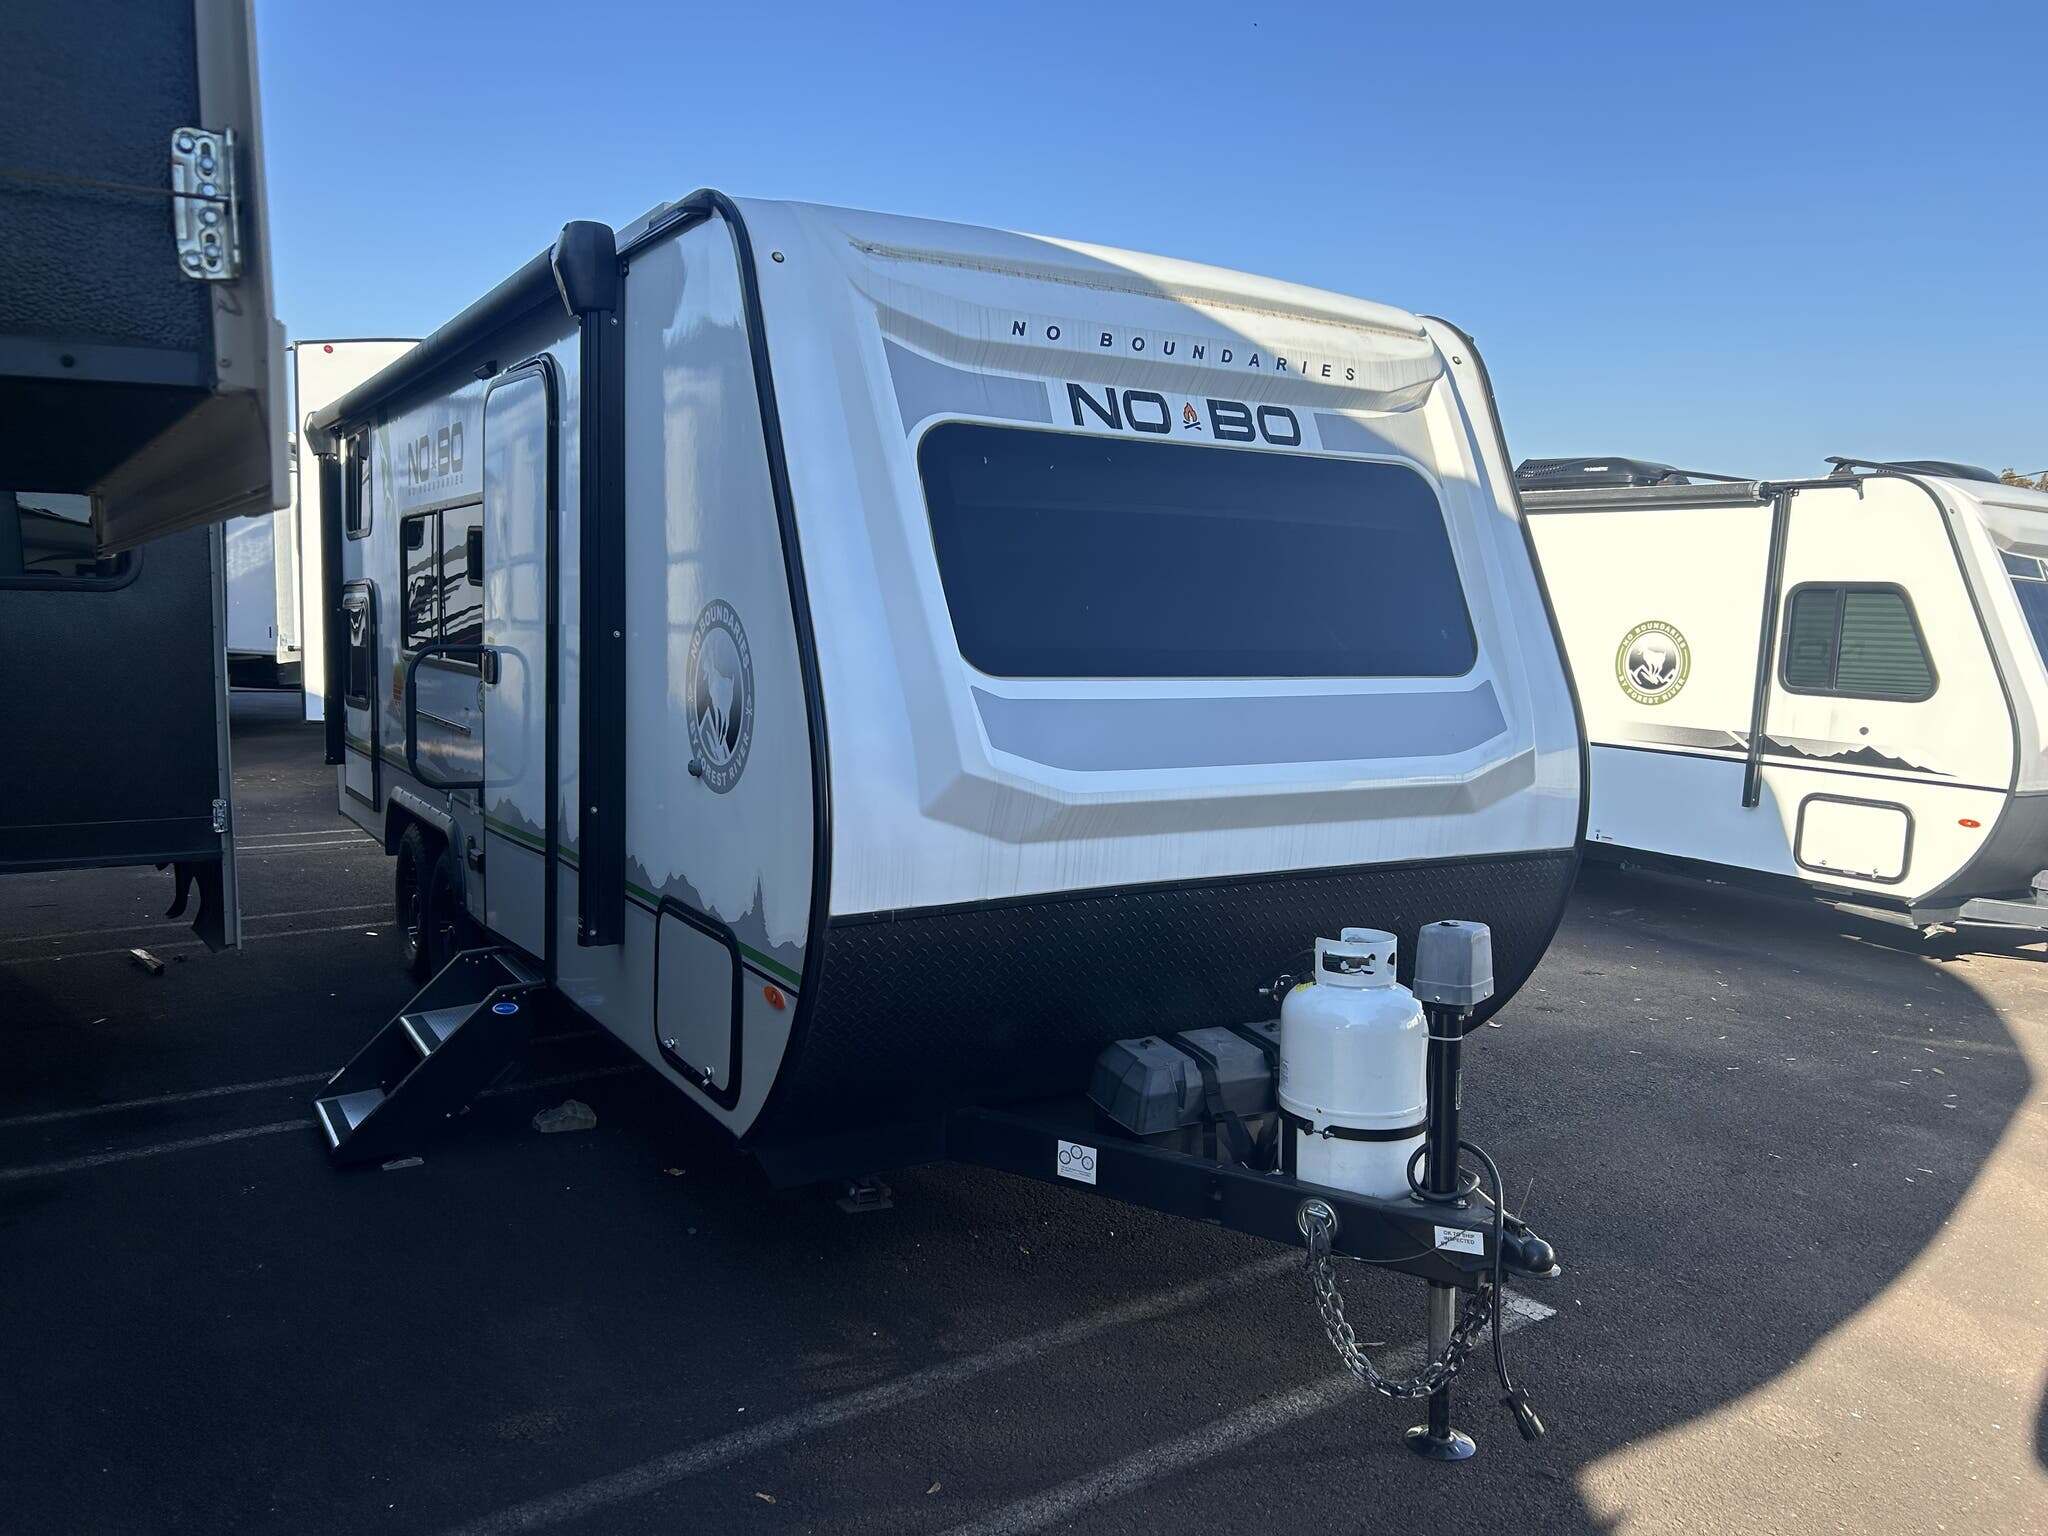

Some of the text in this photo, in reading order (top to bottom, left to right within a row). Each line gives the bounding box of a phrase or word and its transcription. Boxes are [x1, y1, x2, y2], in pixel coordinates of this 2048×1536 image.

[1011, 320, 1356, 382] NO BOUNDARIES
[690, 605, 750, 669] NO BOUNDARIES
[1635, 622, 1687, 649] BOUNDARIES
[1626, 688, 1660, 704] FOREST
[1661, 677, 1685, 702] RIVER
[729, 734, 749, 781] RIVER
